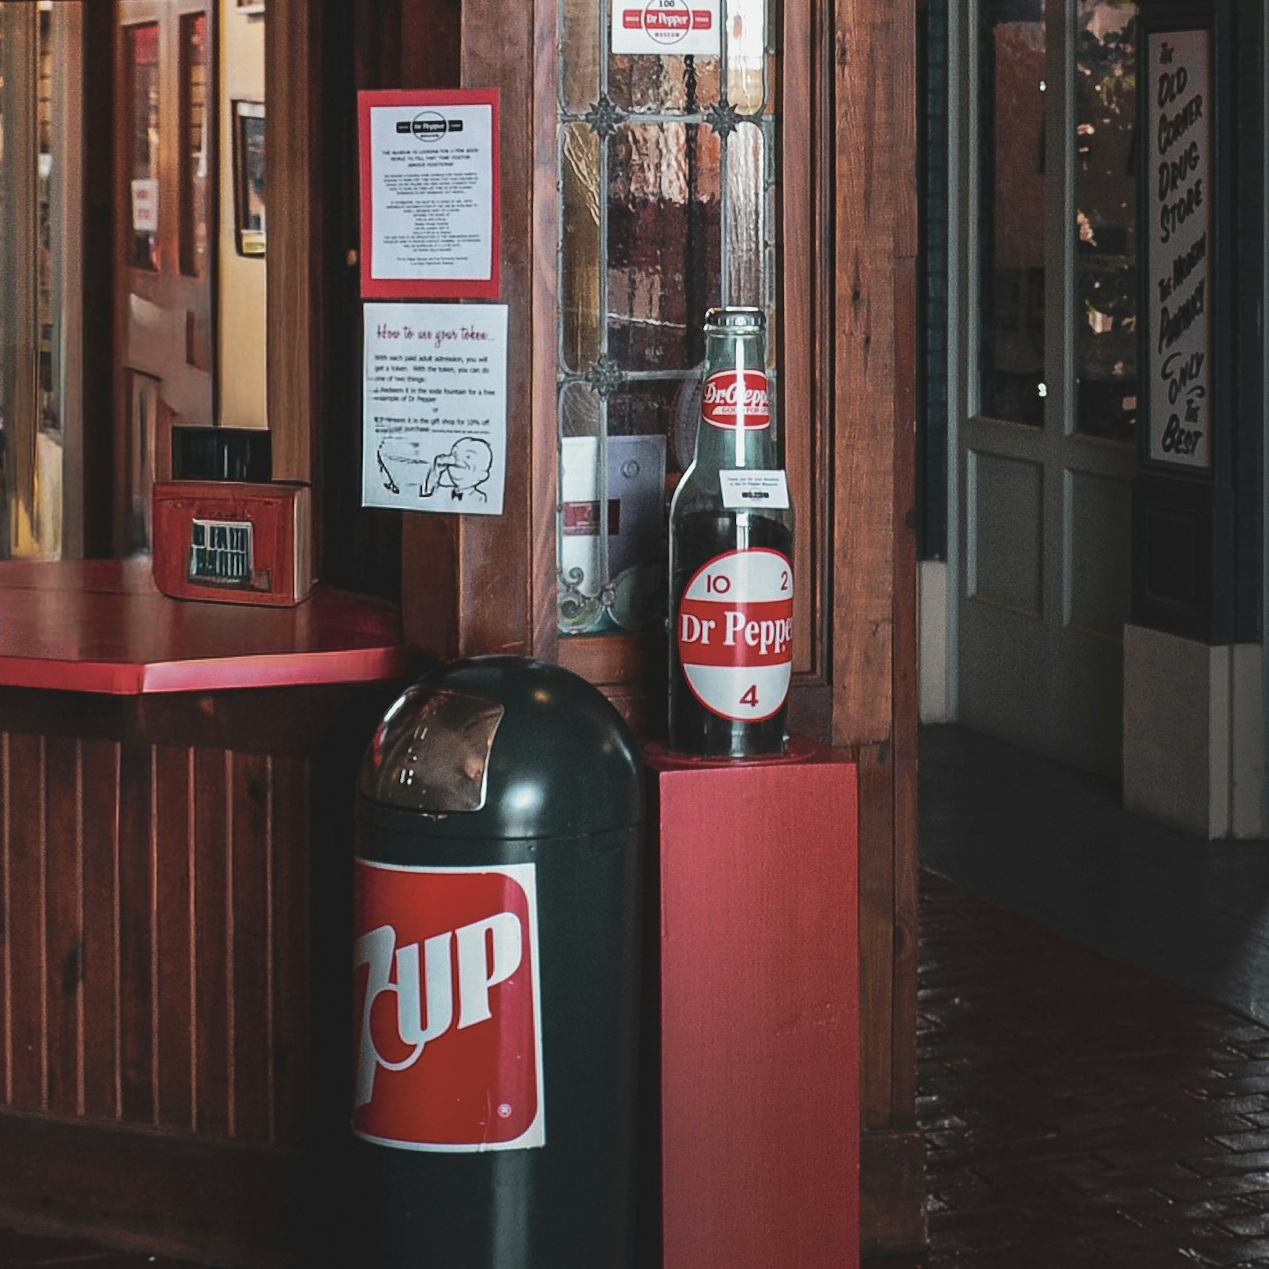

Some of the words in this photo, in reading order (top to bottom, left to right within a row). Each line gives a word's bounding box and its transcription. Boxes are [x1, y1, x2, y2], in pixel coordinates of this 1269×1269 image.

[646, 14, 657, 24] Dr
[658, 12, 689, 27] Pepper
[659, 0, 675, 8] 100
[1157, 66, 1188, 109] OLD
[1157, 94, 1203, 156] CORNER
[1158, 141, 1201, 202] DRUG
[1160, 178, 1203, 244] STORE
[377, 324, 399, 340] How
[403, 326, 413, 340] to
[1168, 352, 1205, 406] ONLY
[1161, 413, 1204, 457] BEST
[706, 575, 731, 594] 10
[780, 571, 789, 591] 2
[681, 614, 716, 645] Dr
[739, 684, 759, 707] 4
